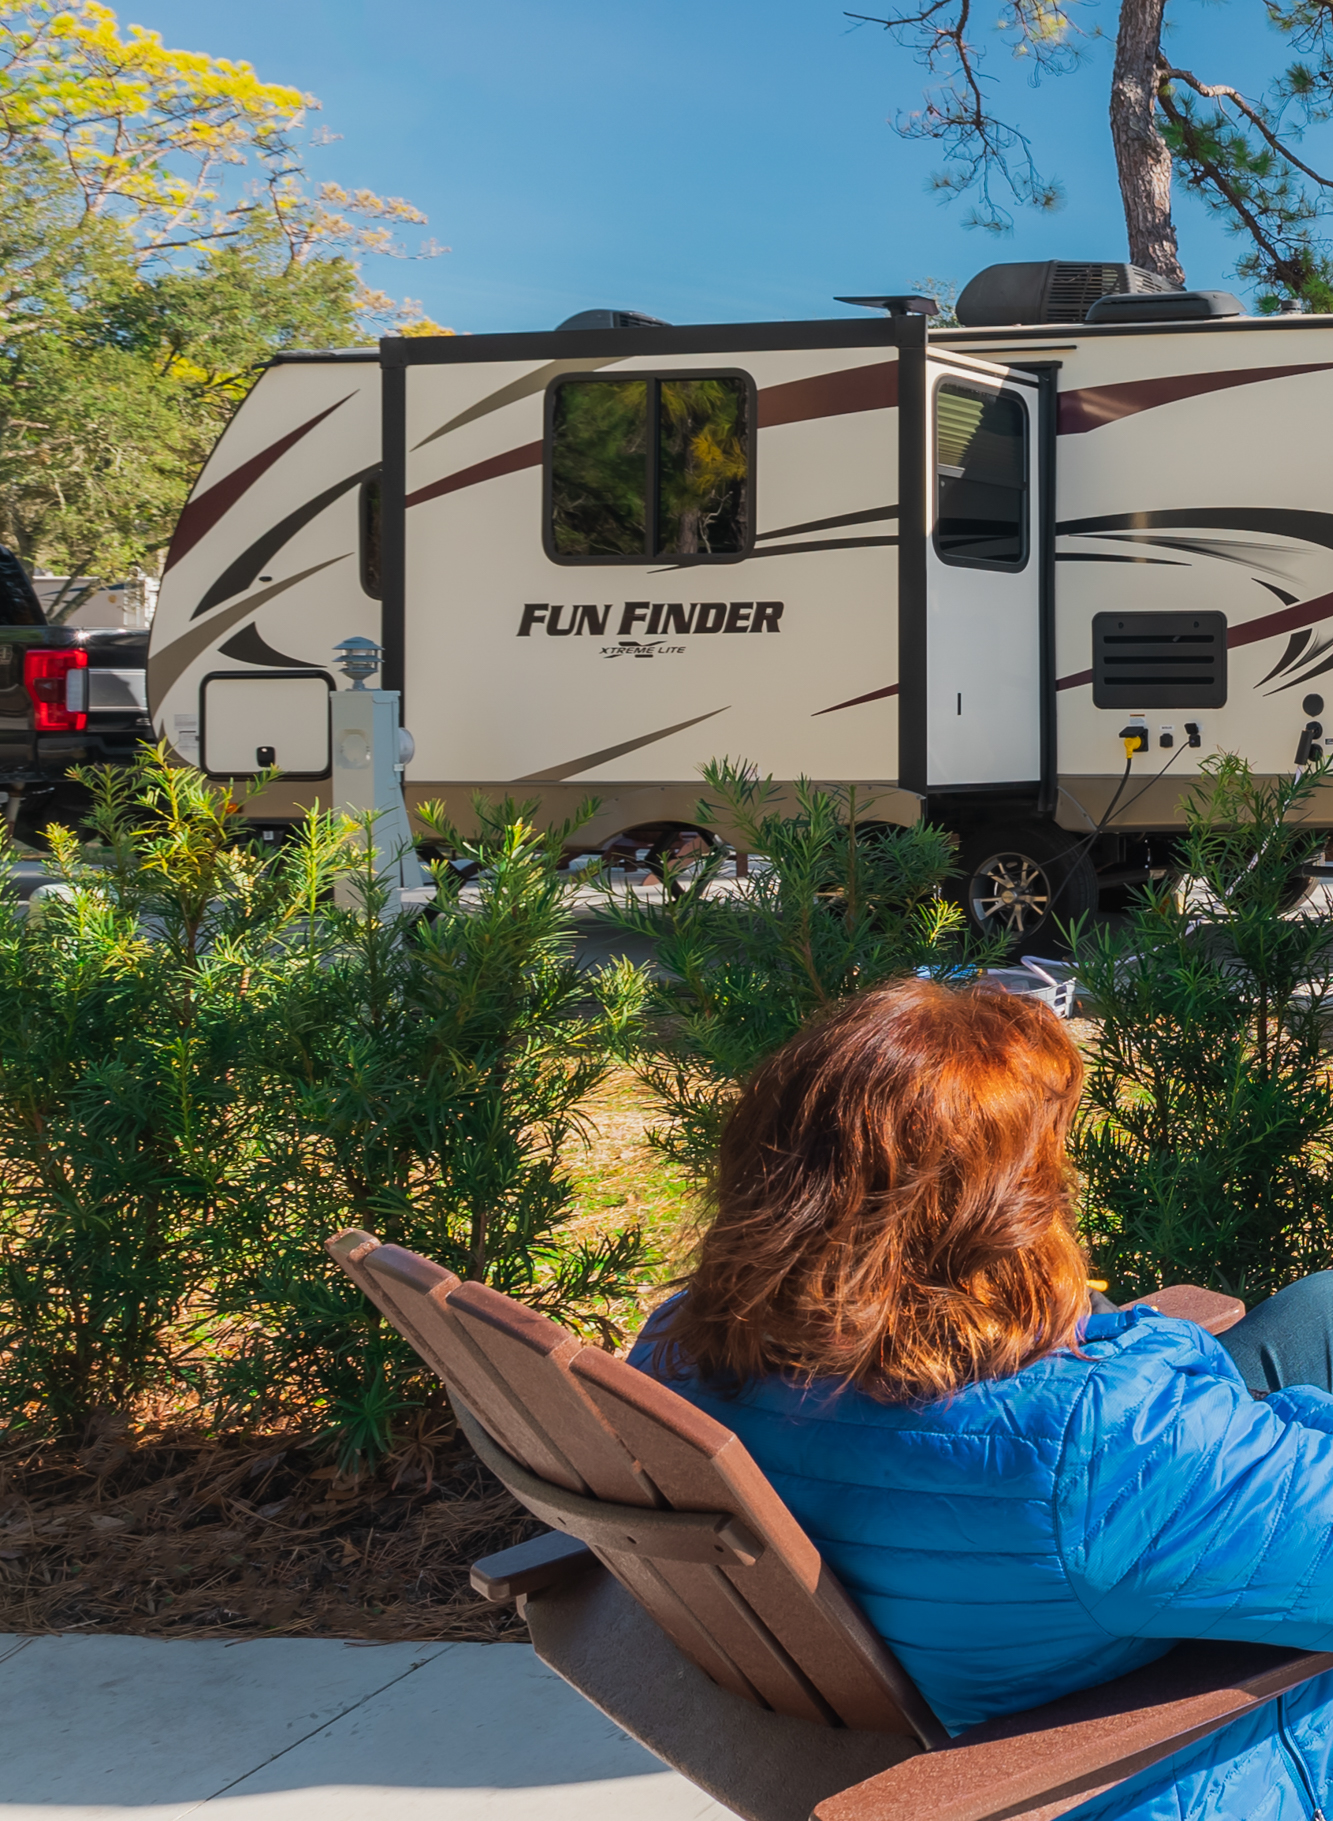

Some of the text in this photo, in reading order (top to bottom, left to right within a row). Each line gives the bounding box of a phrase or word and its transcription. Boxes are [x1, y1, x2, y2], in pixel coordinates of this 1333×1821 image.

[516, 601, 785, 637] FUN FINDER
[599, 646, 687, 655] XTREME LITE
